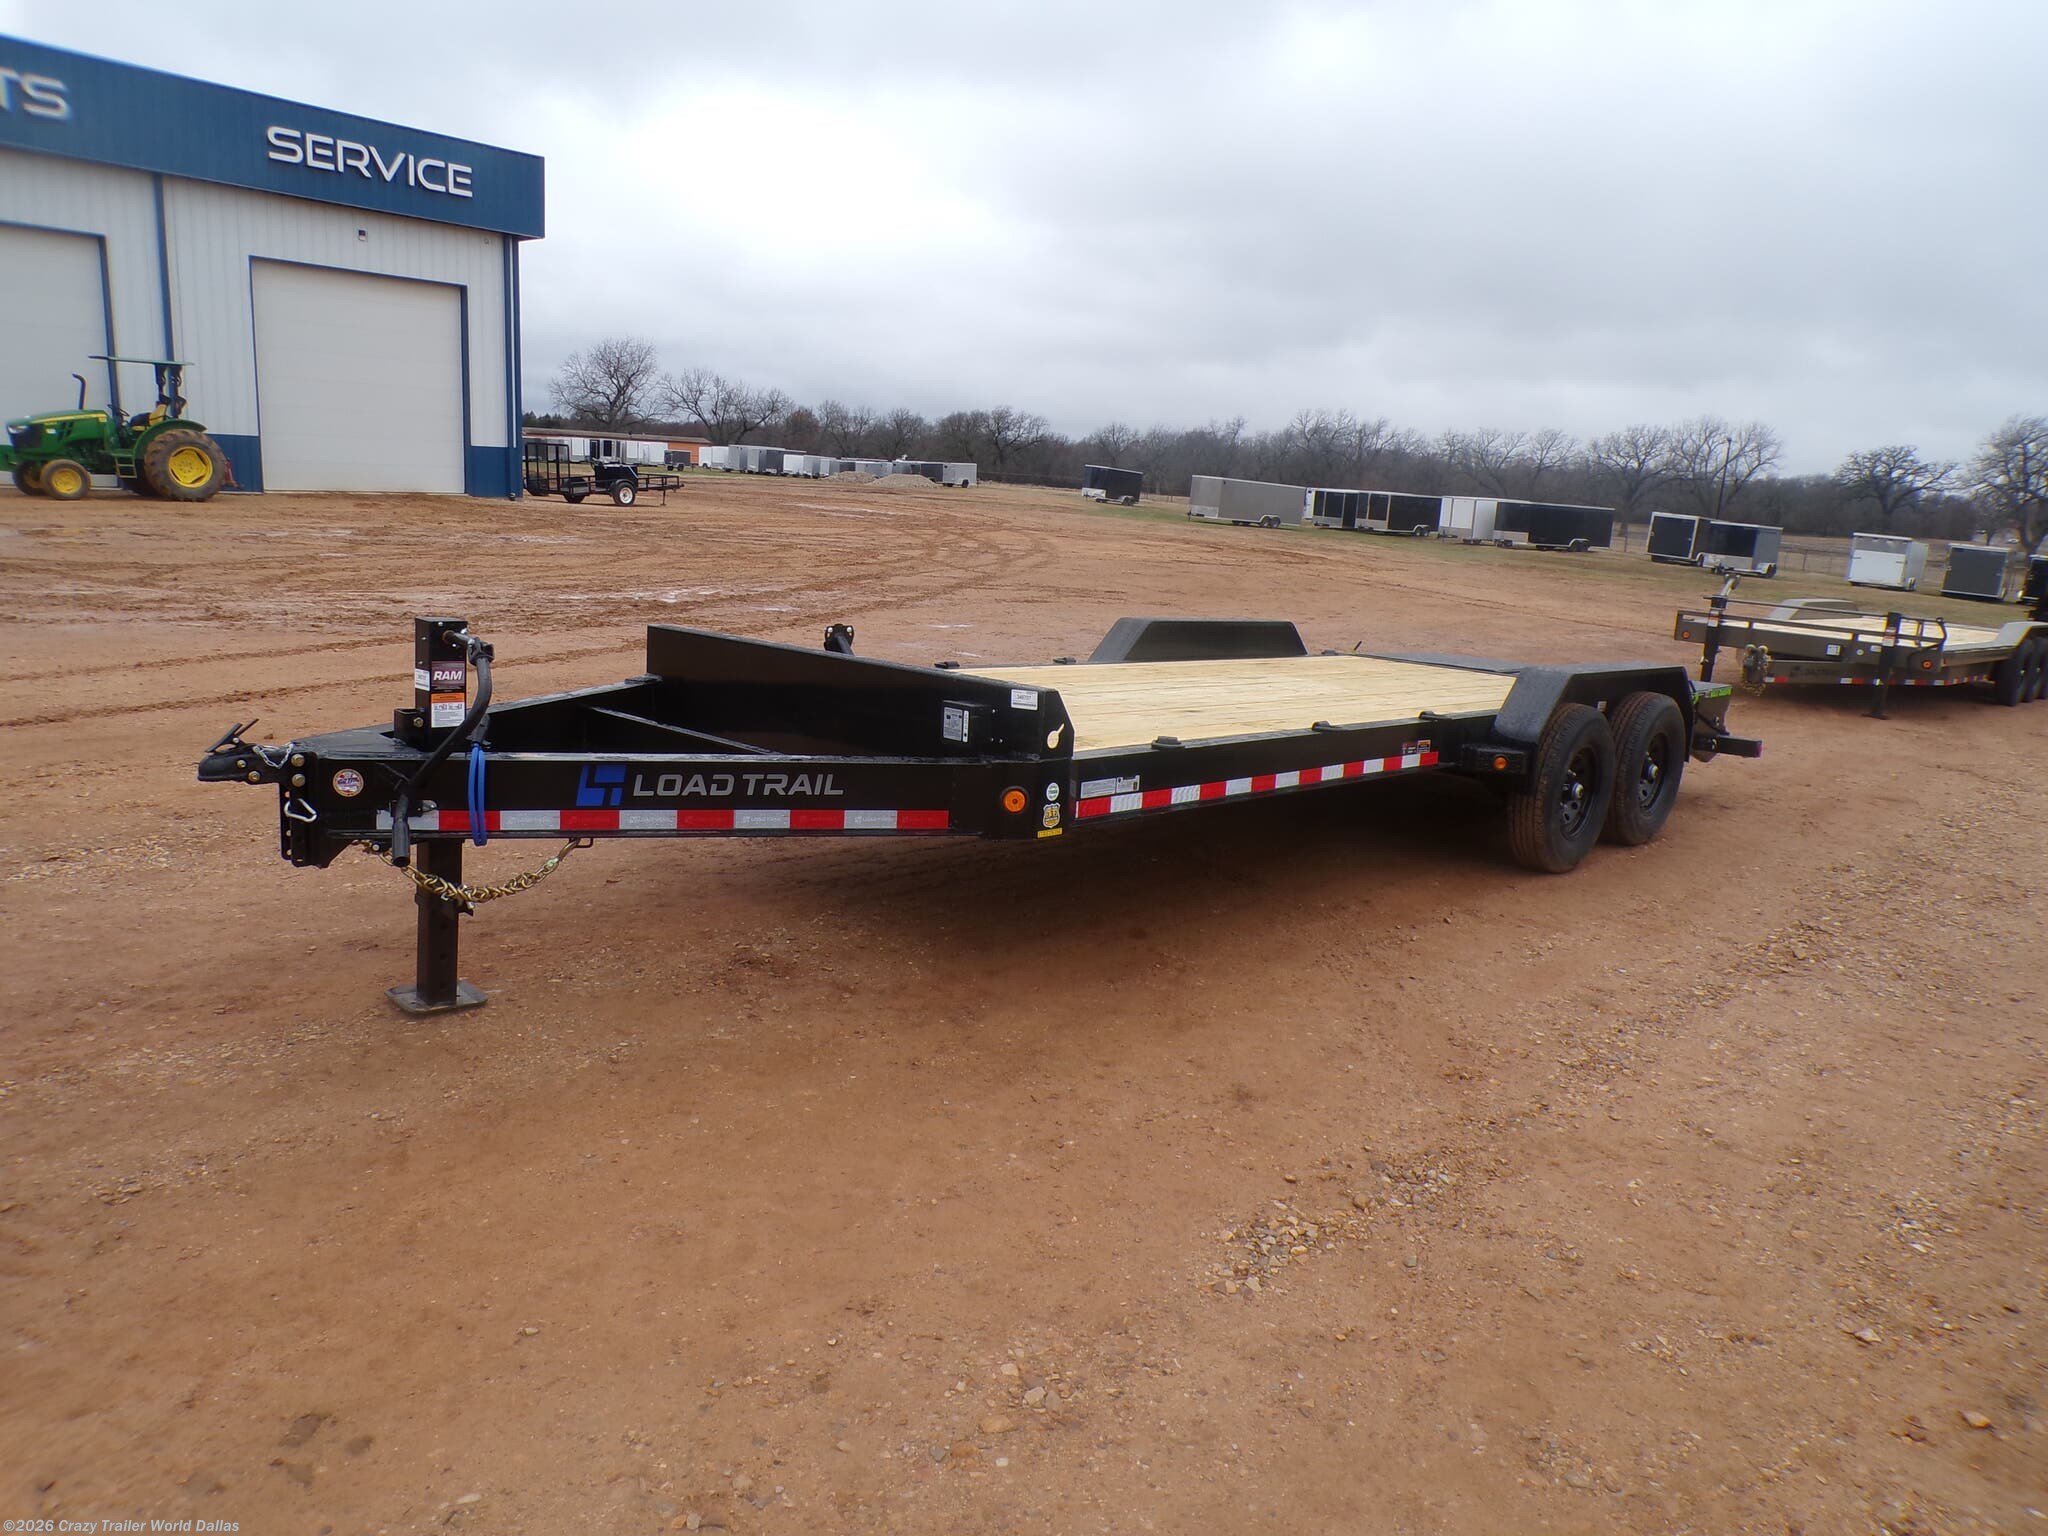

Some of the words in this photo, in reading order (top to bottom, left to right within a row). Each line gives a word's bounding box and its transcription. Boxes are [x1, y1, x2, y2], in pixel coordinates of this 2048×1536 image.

[267, 126, 473, 197] SERVICE
[433, 671, 462, 681] RAM
[633, 774, 735, 796] LOAD
[742, 774, 844, 795] TRAIL
